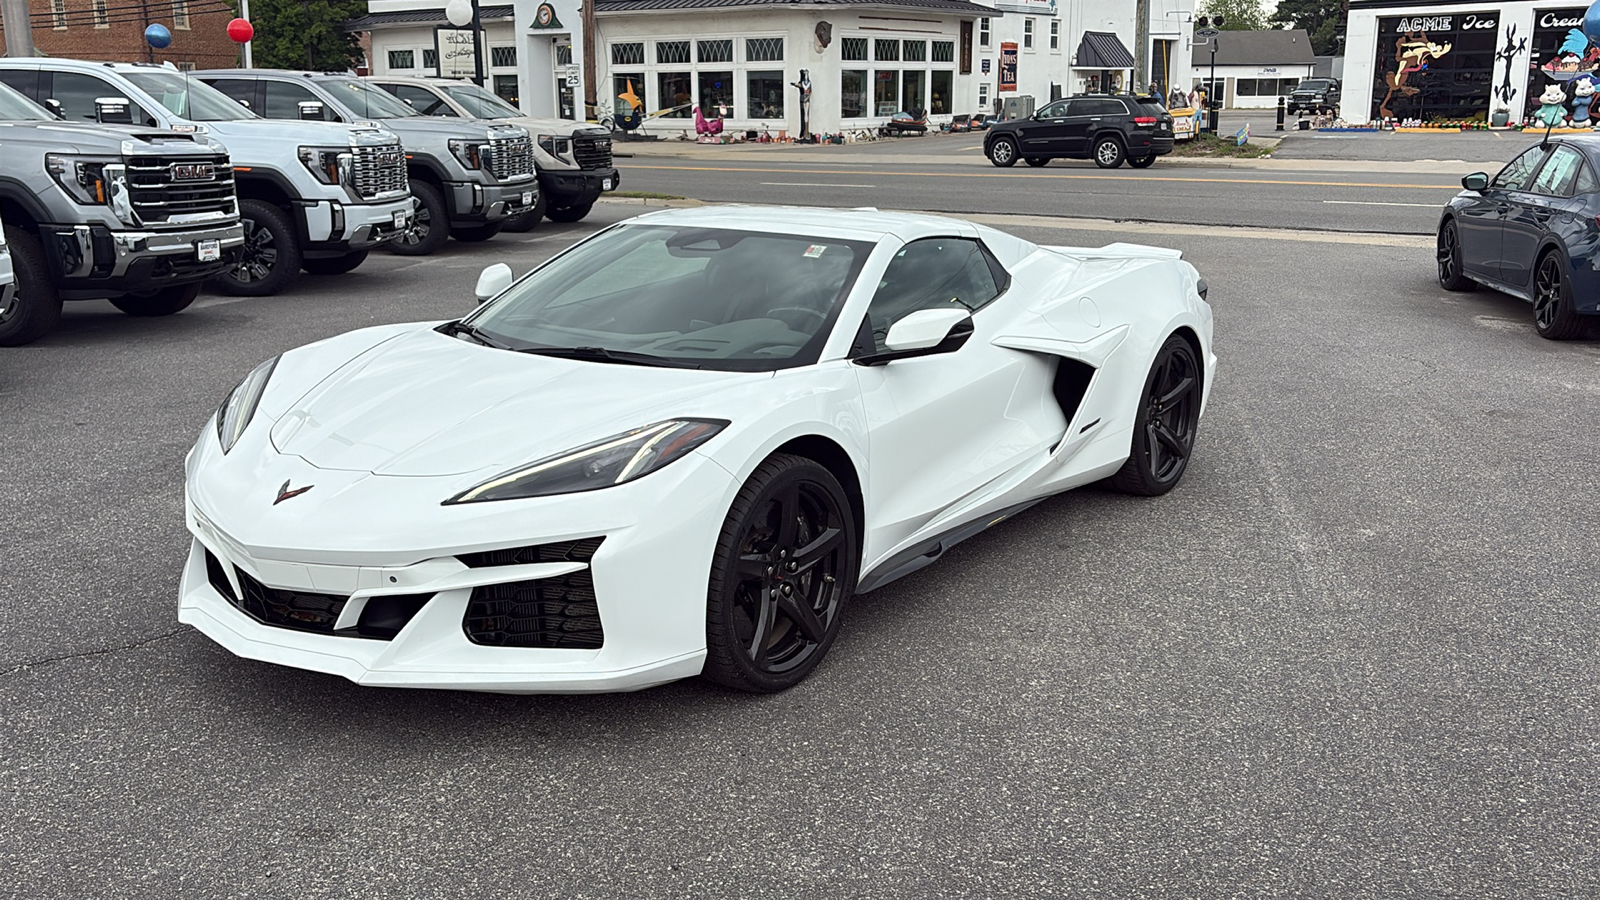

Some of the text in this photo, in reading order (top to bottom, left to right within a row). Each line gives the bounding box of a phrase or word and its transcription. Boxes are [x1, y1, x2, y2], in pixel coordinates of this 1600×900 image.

[1396, 16, 1452, 33] ACME
[1462, 15, 1496, 30] Ice
[568, 76, 579, 84] 25
[176, 165, 212, 179] GMC
